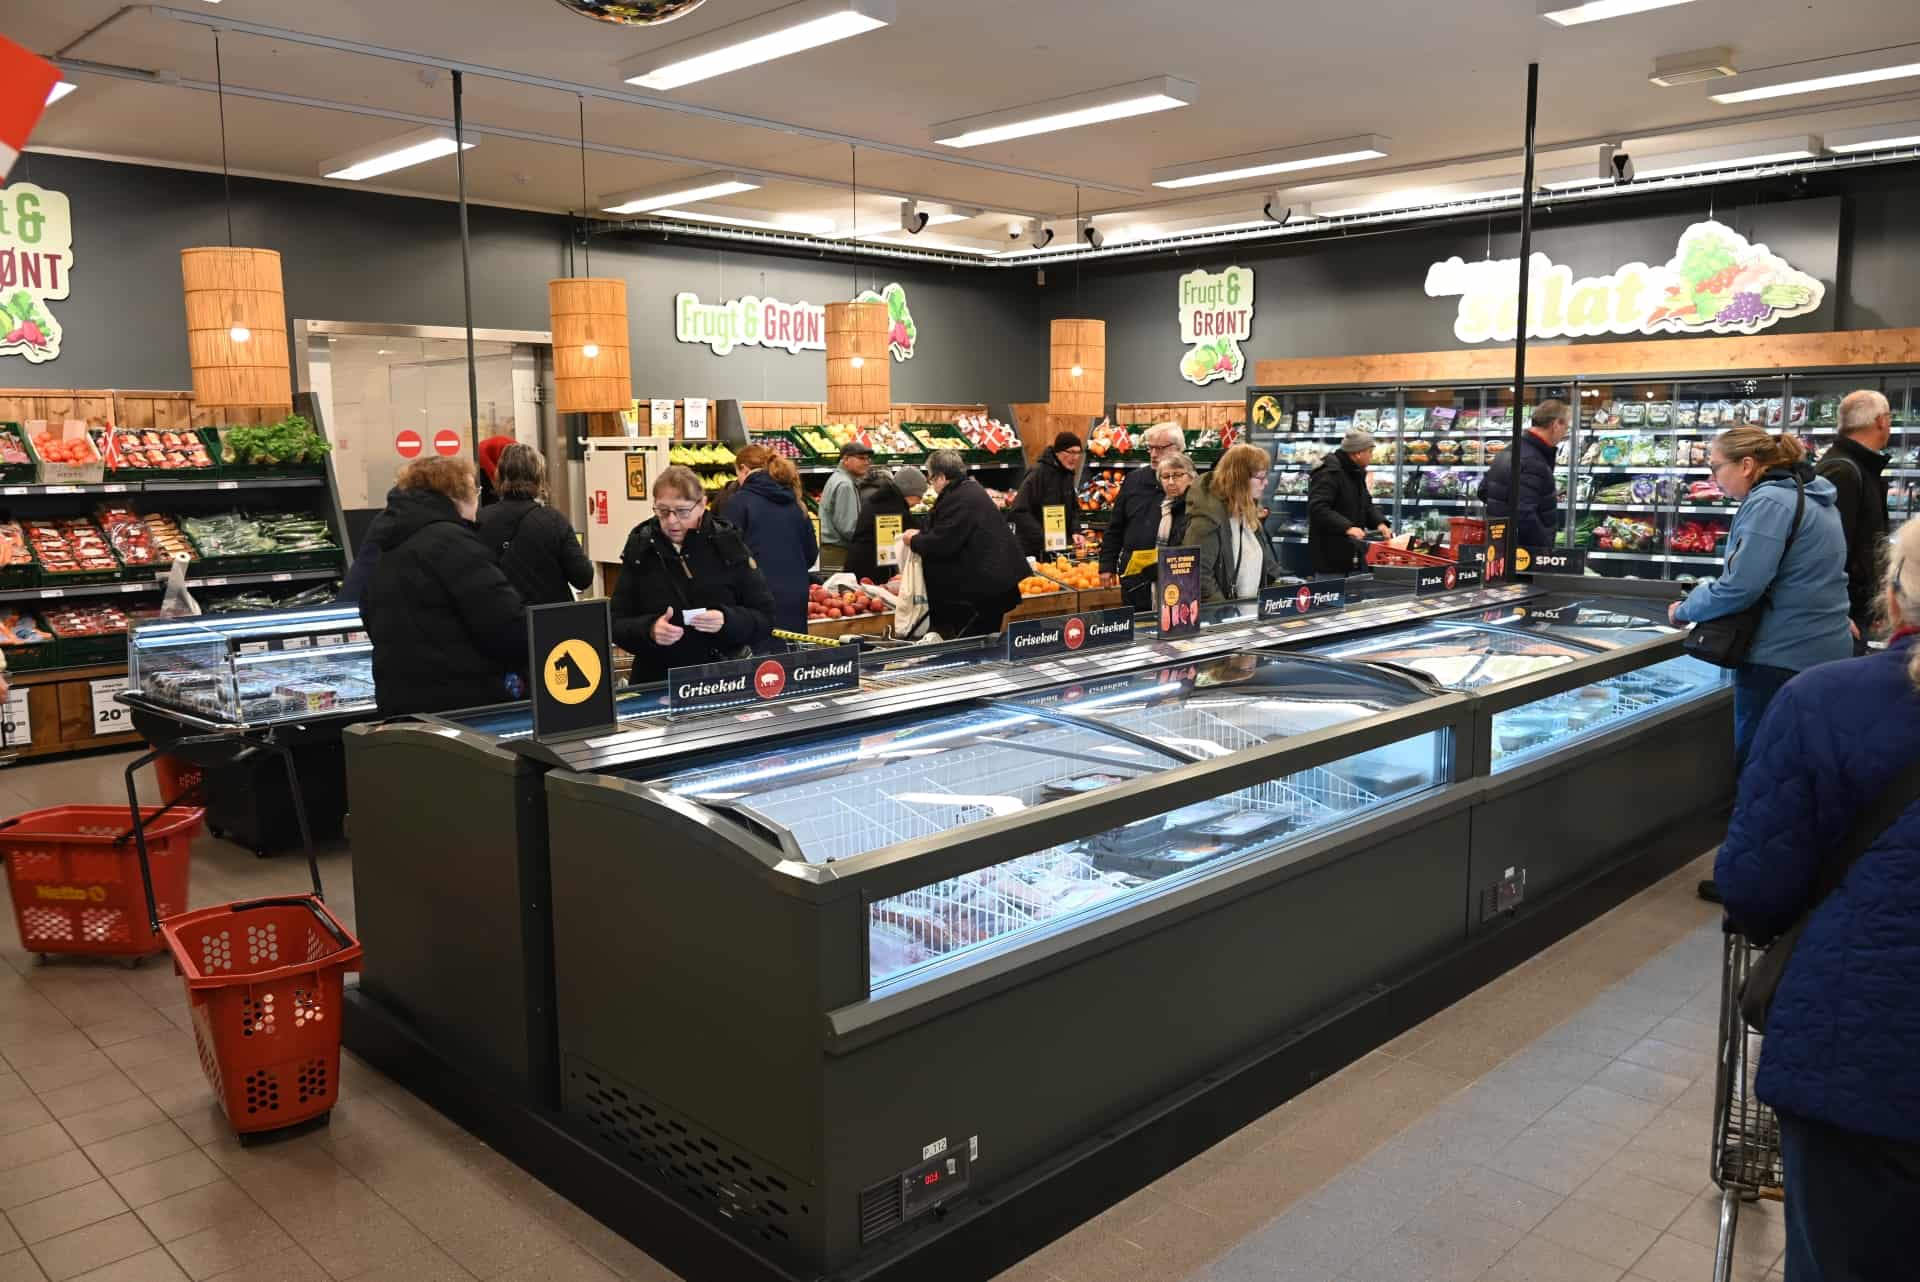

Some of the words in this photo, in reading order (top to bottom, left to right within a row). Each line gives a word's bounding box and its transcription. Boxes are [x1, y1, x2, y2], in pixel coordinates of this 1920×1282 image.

[16, 192, 46, 244] &
[0, 247, 62, 292] ØNT
[1184, 279, 1224, 311] Frugt
[1227, 273, 1241, 305] &
[682, 299, 739, 348] Frugt
[743, 302, 759, 339] &
[1193, 308, 1247, 339] GRØNT
[1535, 555, 1568, 567] SPOT
[1264, 598, 1293, 615] Fjerkræ
[1313, 592, 1340, 606] Fjerkræ
[1014, 630, 1059, 648] Grisekød
[1089, 619, 1130, 636] Grisekød
[678, 675, 746, 699] Grisekød
[793, 660, 852, 681] Grisekød
